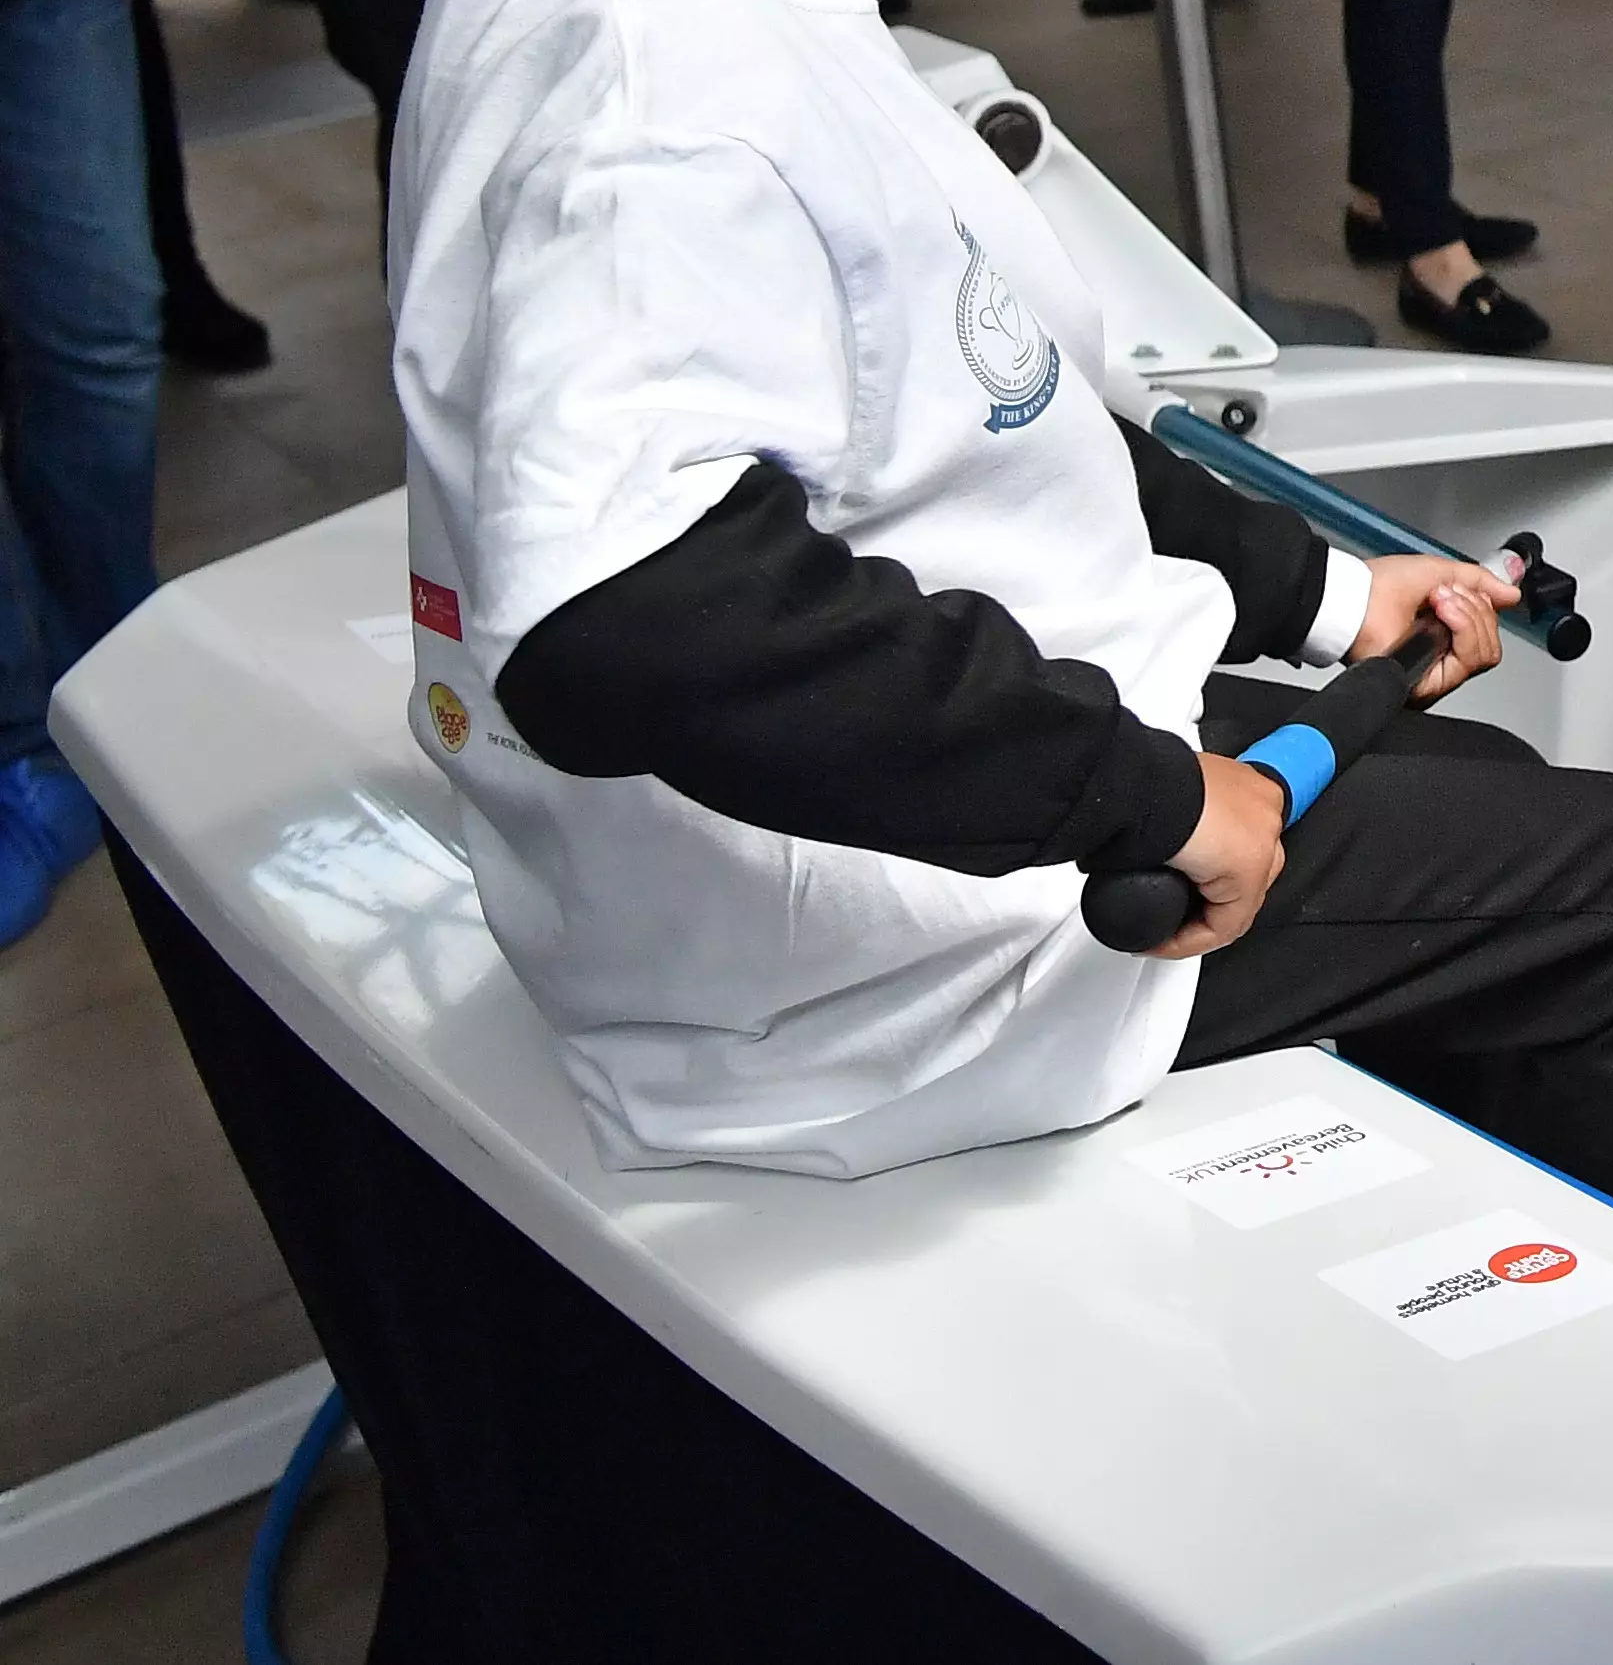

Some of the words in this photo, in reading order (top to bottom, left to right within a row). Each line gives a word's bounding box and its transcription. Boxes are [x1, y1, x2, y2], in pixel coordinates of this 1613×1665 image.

[1001, 410, 1022, 423] THE
[486, 732, 500, 745] THE
[500, 736, 519, 752] ROYAL
[1210, 1123, 1355, 1172] Bereavement
[1311, 1131, 1367, 1154] Child
[1175, 1169, 1216, 1184] UK
[1507, 1252, 1571, 1280] centre
[1424, 1272, 1474, 1292] future
[1444, 1272, 1494, 1293] young
[1471, 1278, 1502, 1293] give
[1396, 1289, 1446, 1311] people
[1397, 1290, 1473, 1319] homeless
